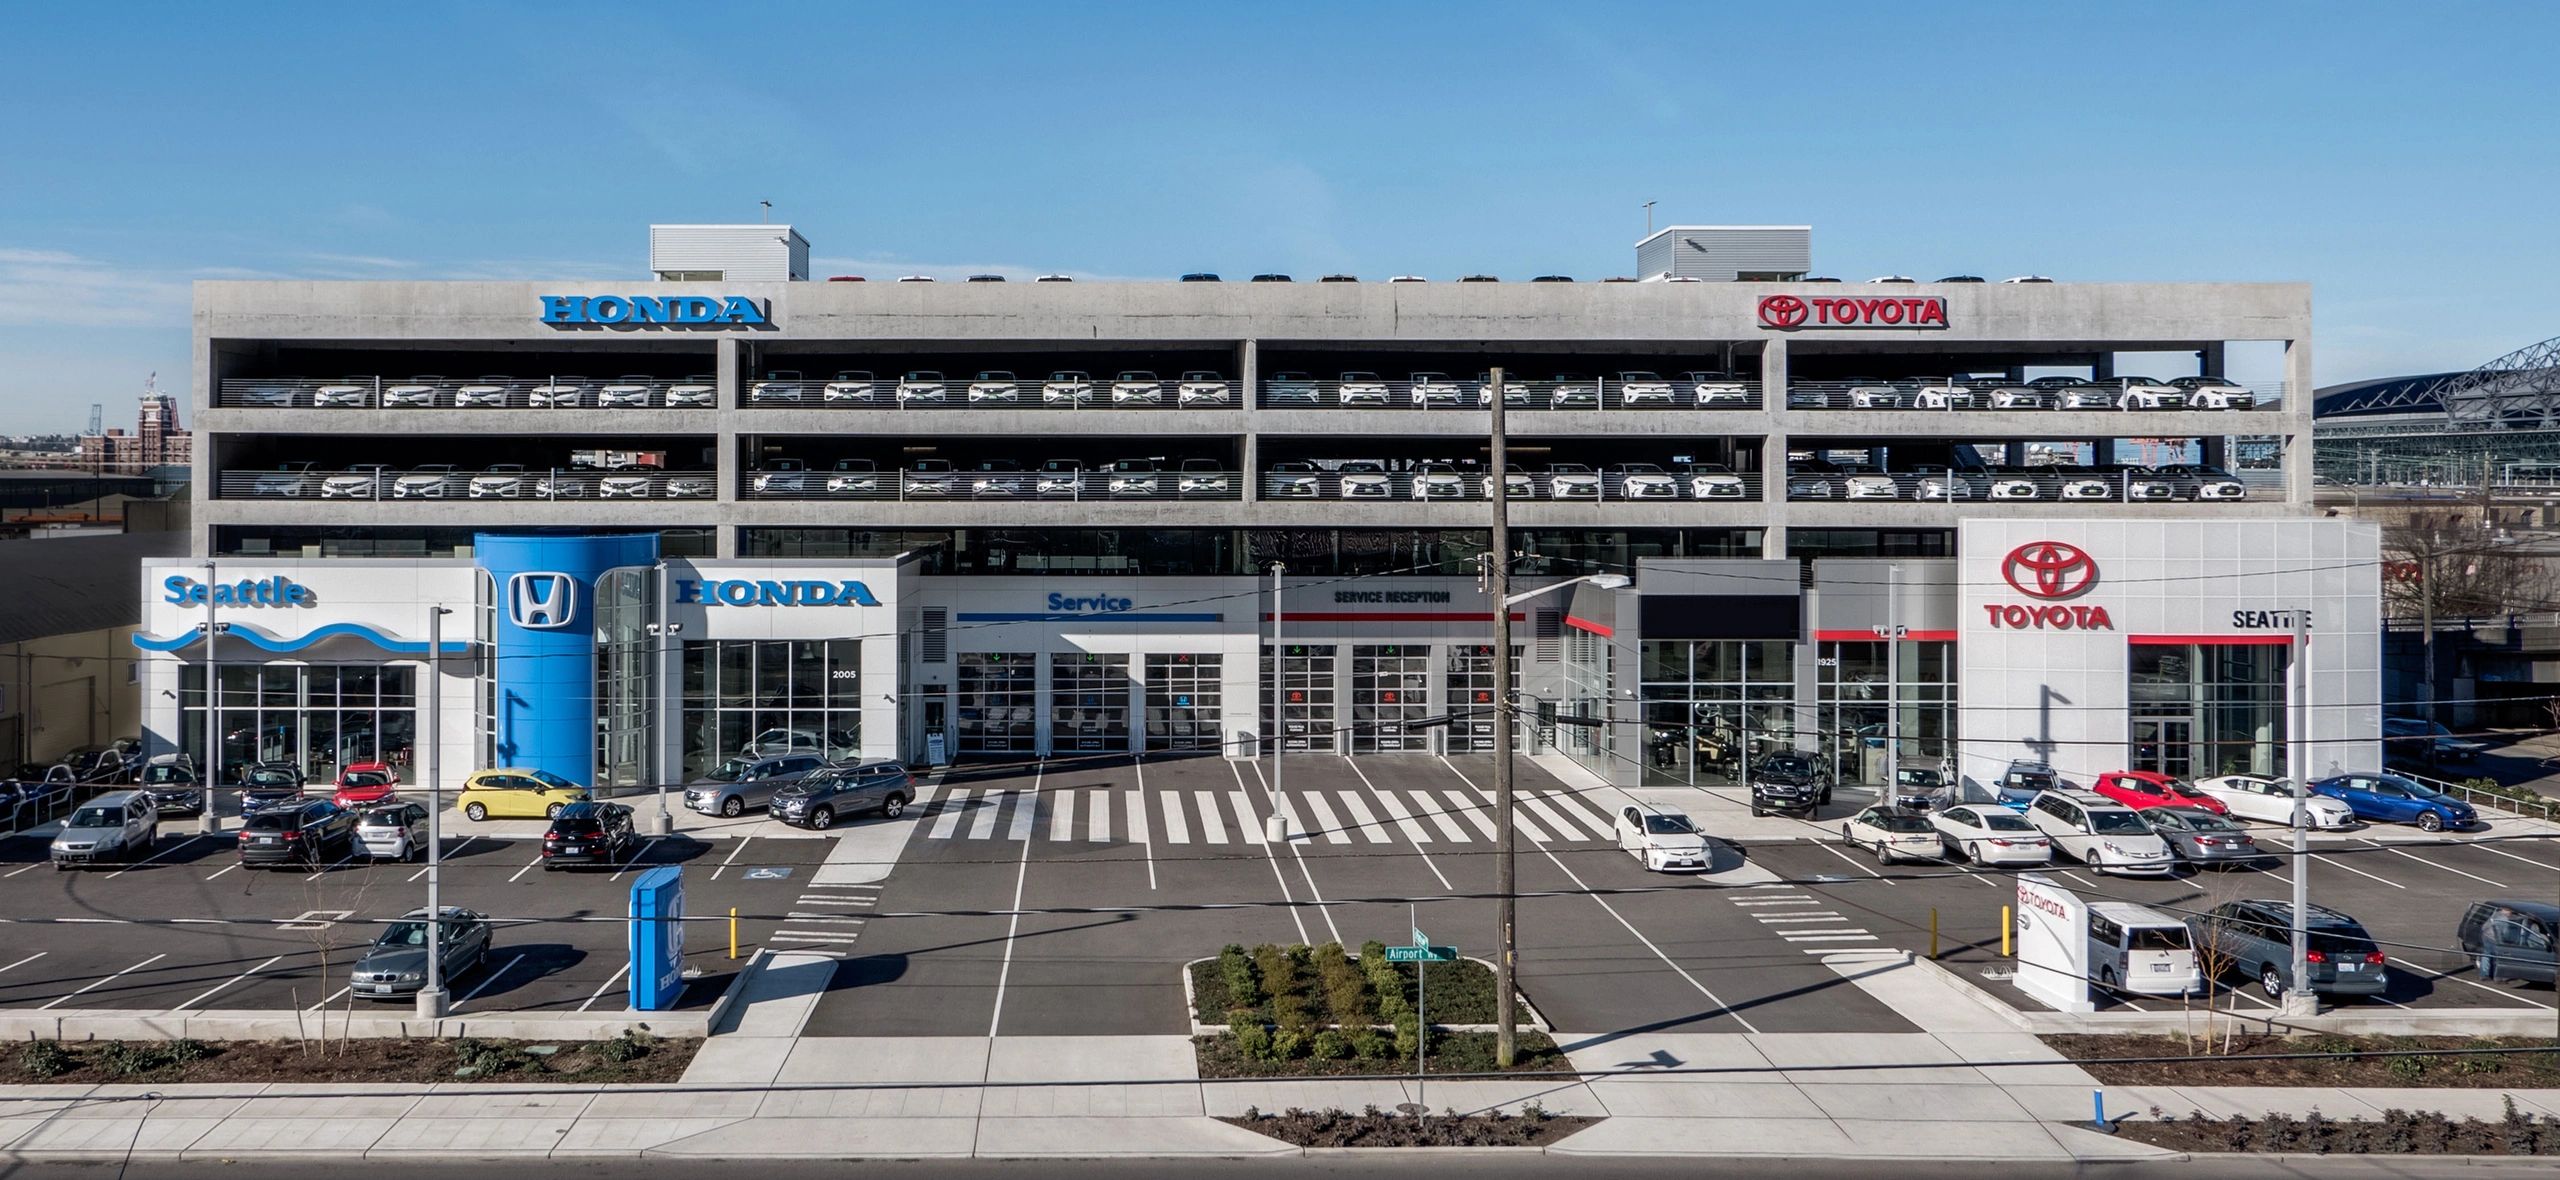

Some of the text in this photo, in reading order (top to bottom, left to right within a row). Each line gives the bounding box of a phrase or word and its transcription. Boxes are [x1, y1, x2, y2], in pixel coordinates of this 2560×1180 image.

[539, 295, 766, 324] HONDA
[1812, 298, 1945, 324] TOYOTA
[164, 575, 305, 604] Seattle
[675, 579, 881, 606] HONDA
[1334, 591, 1451, 603] SERVICE RECEPTION
[1047, 592, 1133, 611] Service
[1984, 604, 2113, 630] TOYOTA
[2232, 610, 2313, 628] SEATTE
[1817, 658, 1837, 666] 1925
[832, 670, 857, 679] 2005
[2029, 891, 2067, 919] TOYOTA
[1389, 947, 1423, 960] Airport
